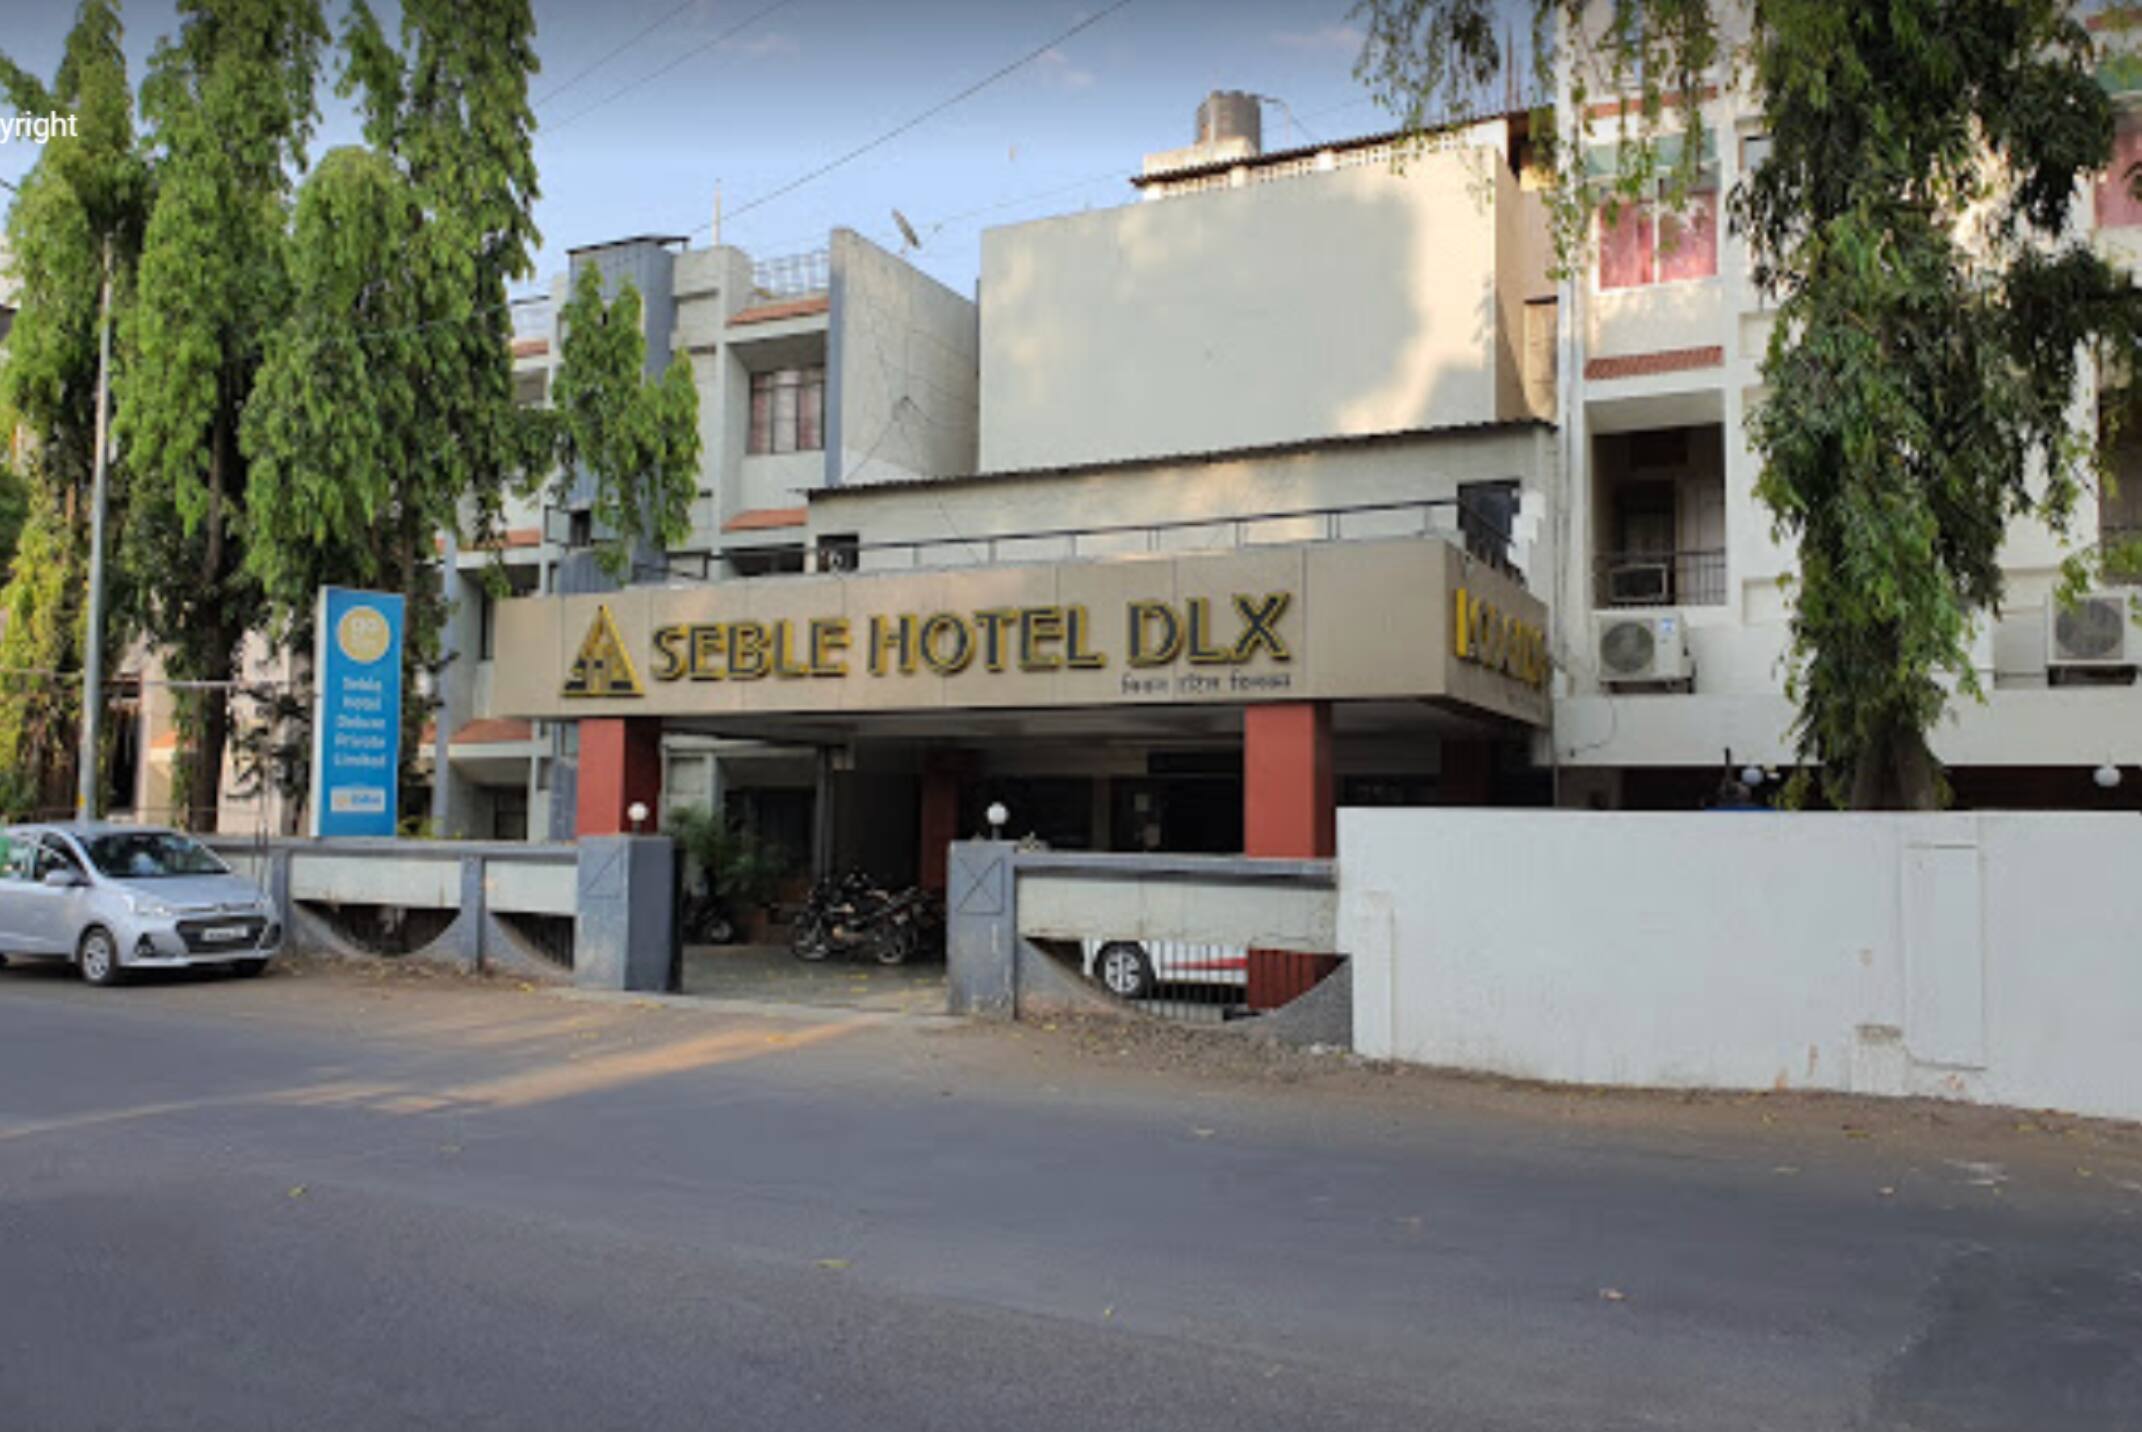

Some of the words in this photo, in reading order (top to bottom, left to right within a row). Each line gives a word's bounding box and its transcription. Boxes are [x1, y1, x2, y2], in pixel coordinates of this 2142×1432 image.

[652, 618, 851, 681] SEBLE
[867, 603, 1107, 678] HOTEL
[1126, 592, 1292, 668] DLX
